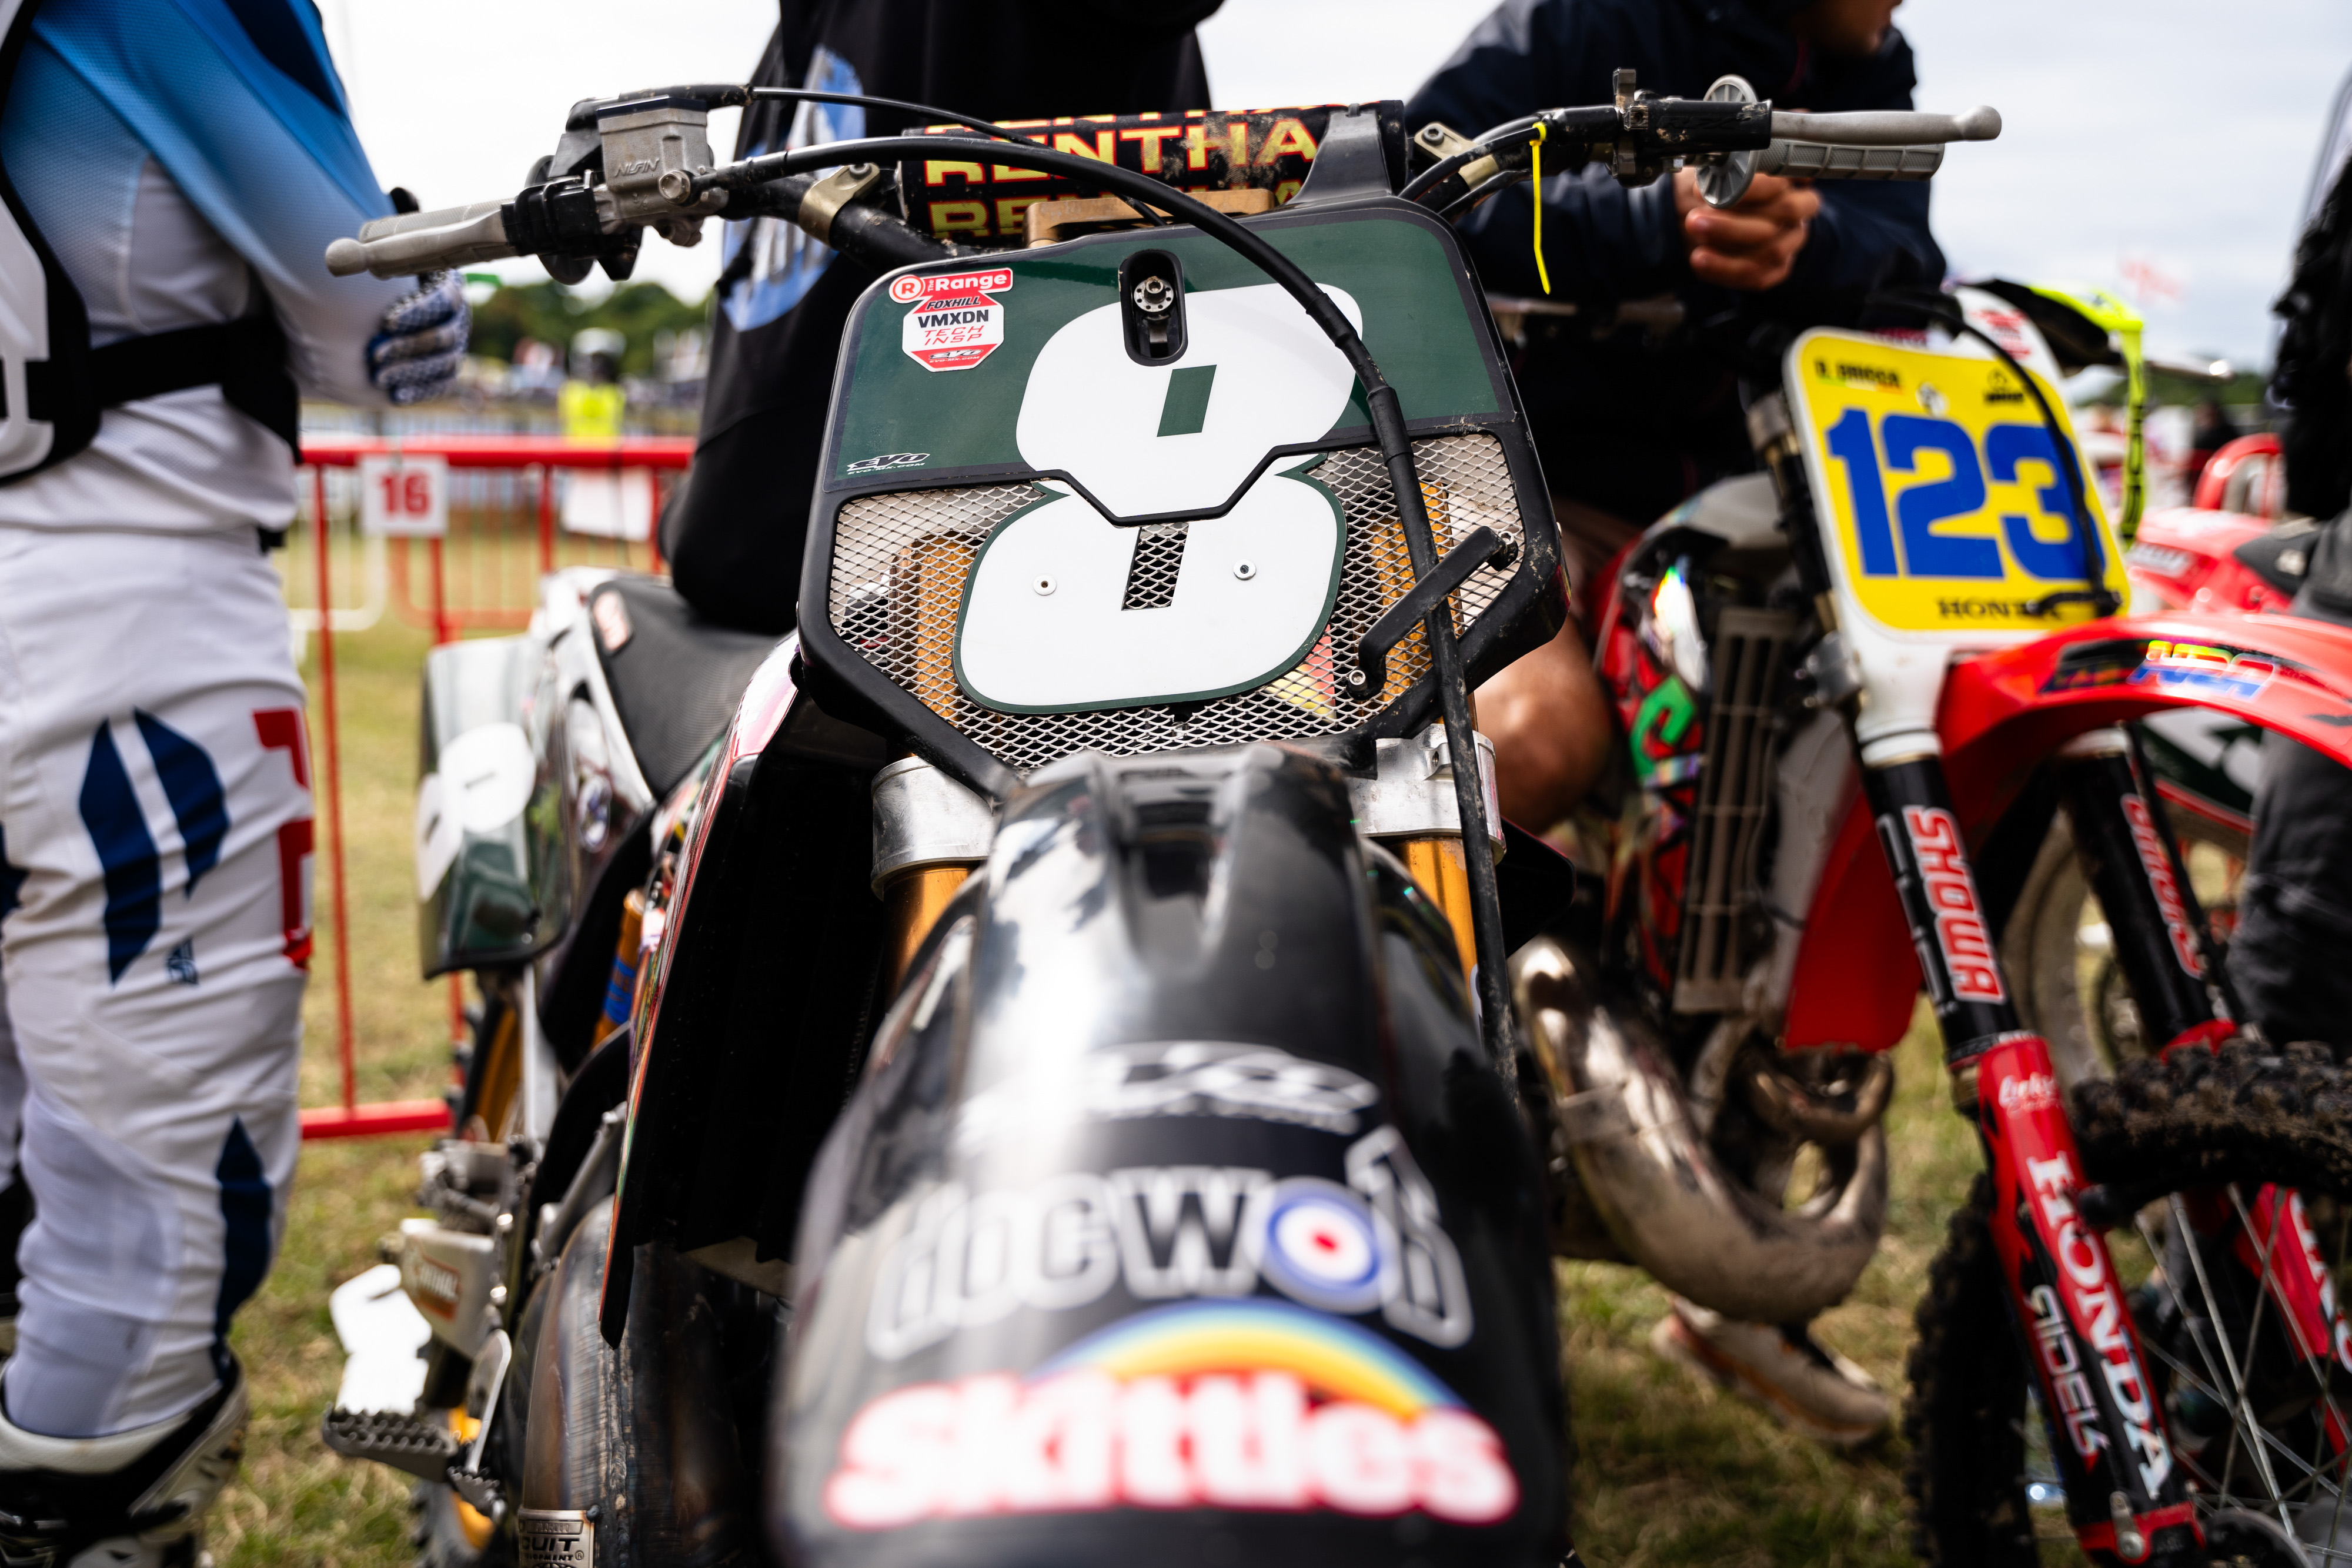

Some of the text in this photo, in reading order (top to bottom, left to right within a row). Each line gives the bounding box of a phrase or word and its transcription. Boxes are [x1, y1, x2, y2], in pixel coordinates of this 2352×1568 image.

[922, 118, 1320, 188] RENTHA
[935, 274, 1007, 292] Range
[925, 296, 981, 310] FOXHILL
[917, 309, 990, 329] VMXDN
[924, 325, 984, 338] TECH
[924, 333, 983, 346] INSP
[847, 463, 925, 475] EVO-MX.COM
[380, 473, 431, 516] 16
[1825, 407, 2109, 581] 123
[1902, 805, 2006, 1004] SHOWA
[2026, 1149, 2174, 1500] HONDA
[824, 1369, 1523, 1530] Skittles
